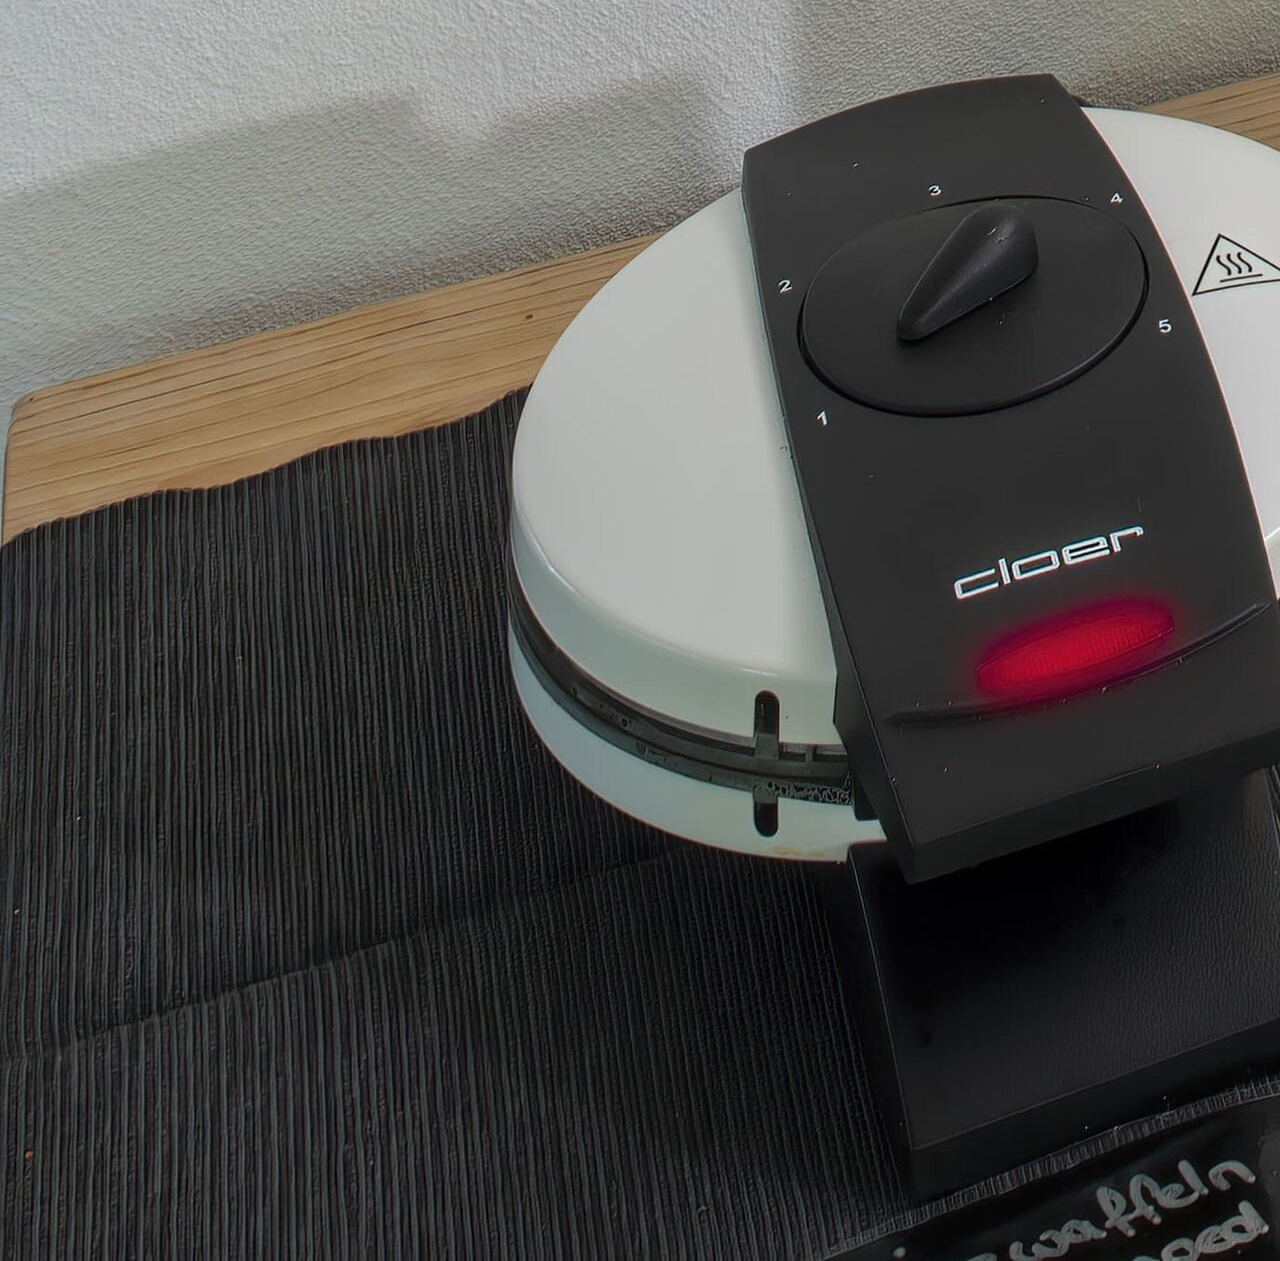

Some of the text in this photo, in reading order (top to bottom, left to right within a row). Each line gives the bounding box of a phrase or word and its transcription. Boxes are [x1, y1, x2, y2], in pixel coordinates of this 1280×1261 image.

[929, 184, 942, 197] 3
[1110, 192, 1124, 204] 4
[778, 280, 793, 294] 2
[1158, 319, 1172, 334] 5
[816, 409, 829, 426] 1
[953, 526, 1145, 601] cloer
[1132, 1200, 1270, 1261] ood
